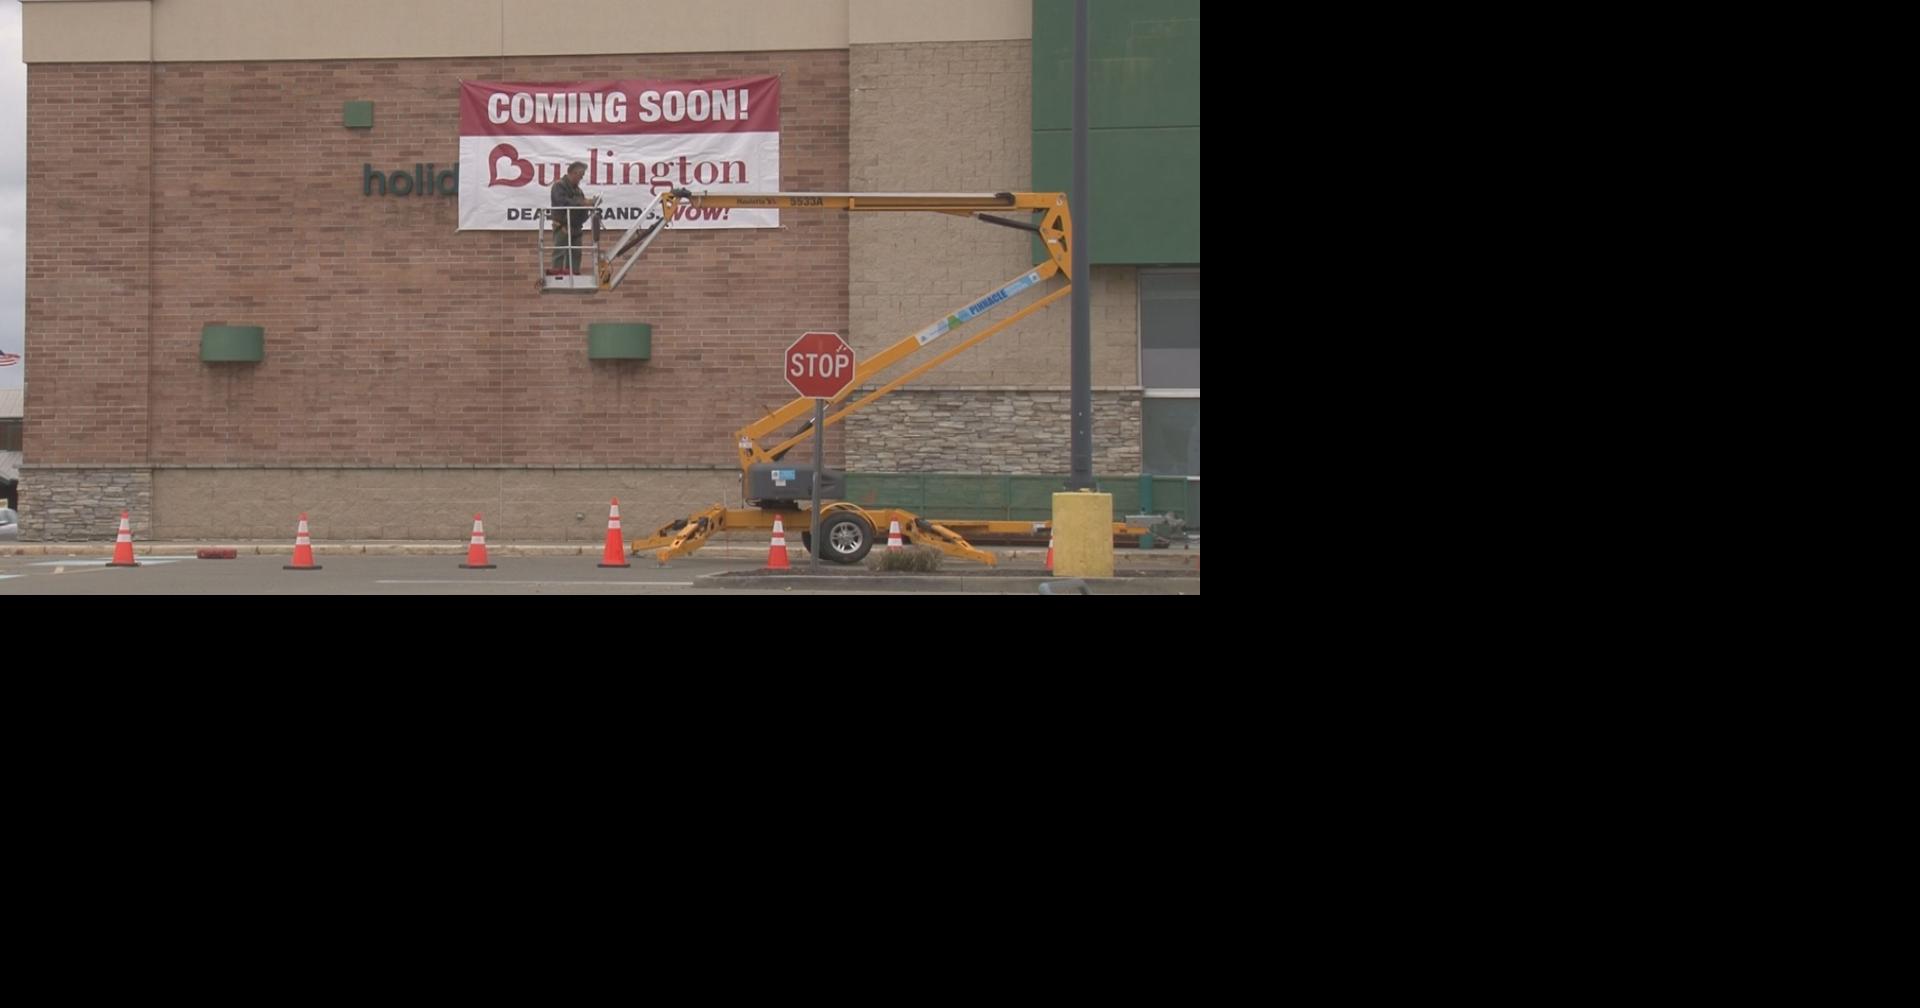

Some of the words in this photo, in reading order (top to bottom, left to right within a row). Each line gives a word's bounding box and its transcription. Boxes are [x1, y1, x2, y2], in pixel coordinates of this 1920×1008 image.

[487, 91, 627, 124] COMING
[639, 88, 750, 121] SOON!
[363, 162, 459, 197] holid
[488, 143, 750, 197] Bulington
[968, 287, 1009, 316] PINNACLE
[790, 352, 850, 379] STOP
